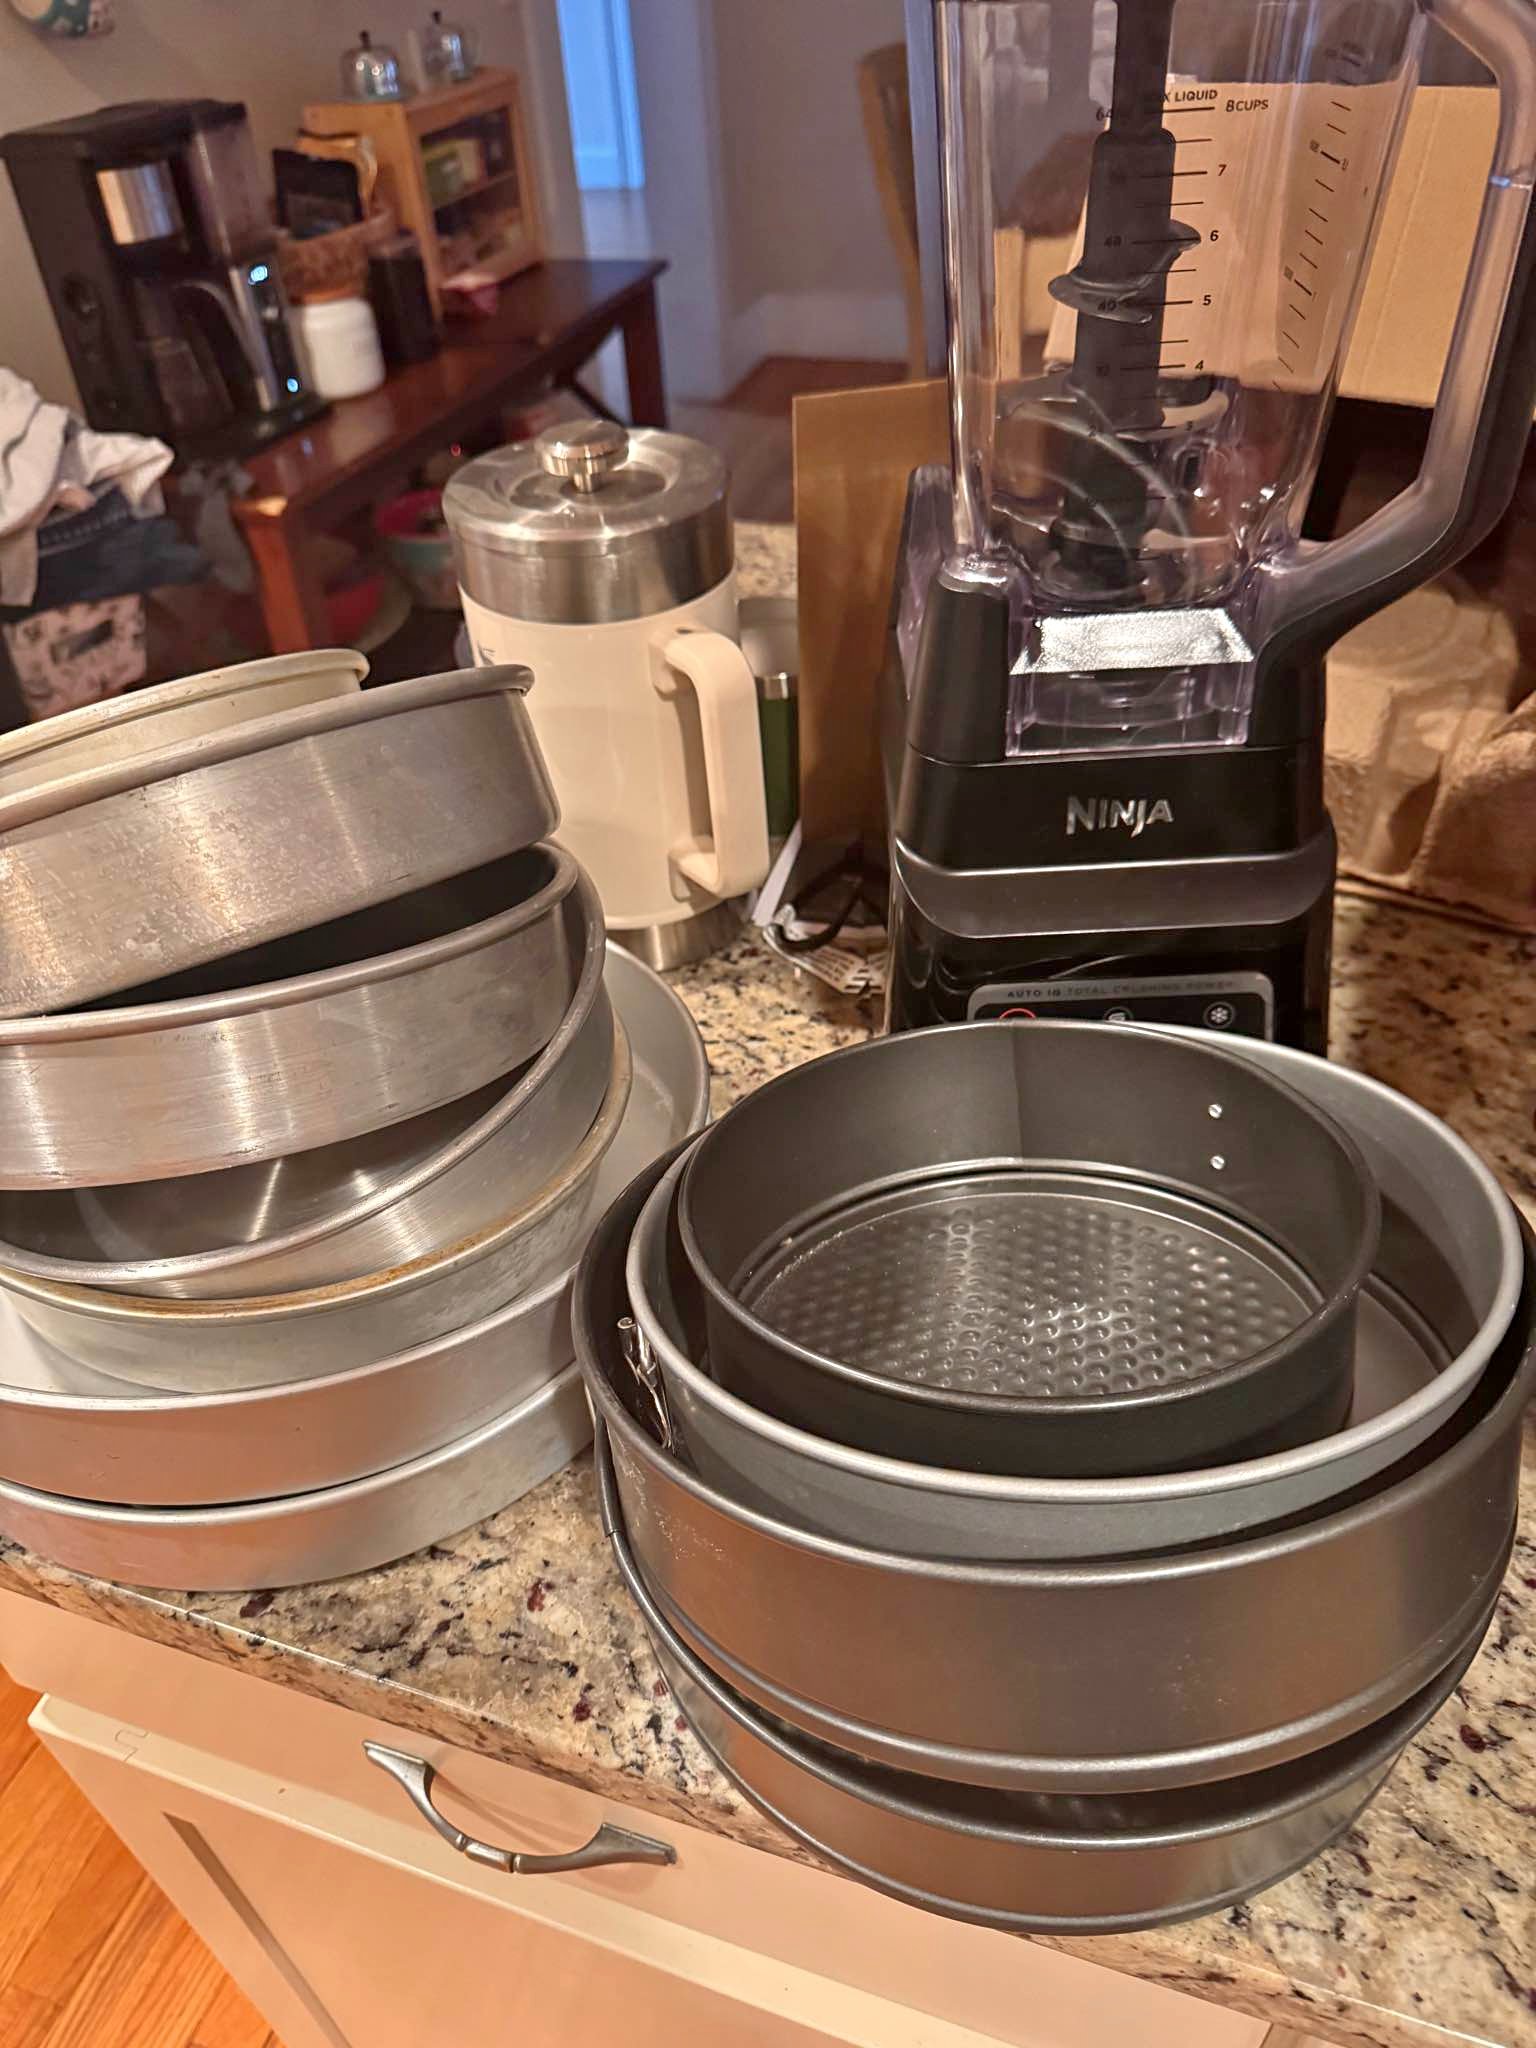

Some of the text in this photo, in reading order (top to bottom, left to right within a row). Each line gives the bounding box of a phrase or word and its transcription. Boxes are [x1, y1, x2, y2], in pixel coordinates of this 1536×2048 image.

[1174, 90, 1219, 102] LIQUID
[1217, 163, 1227, 176] 7
[1210, 230, 1219, 242] 6
[1203, 295, 1212, 306] 5
[1195, 360, 1204, 370] 4
[1066, 796, 1175, 838] NINJA
[1007, 990, 1041, 998] AUTO
